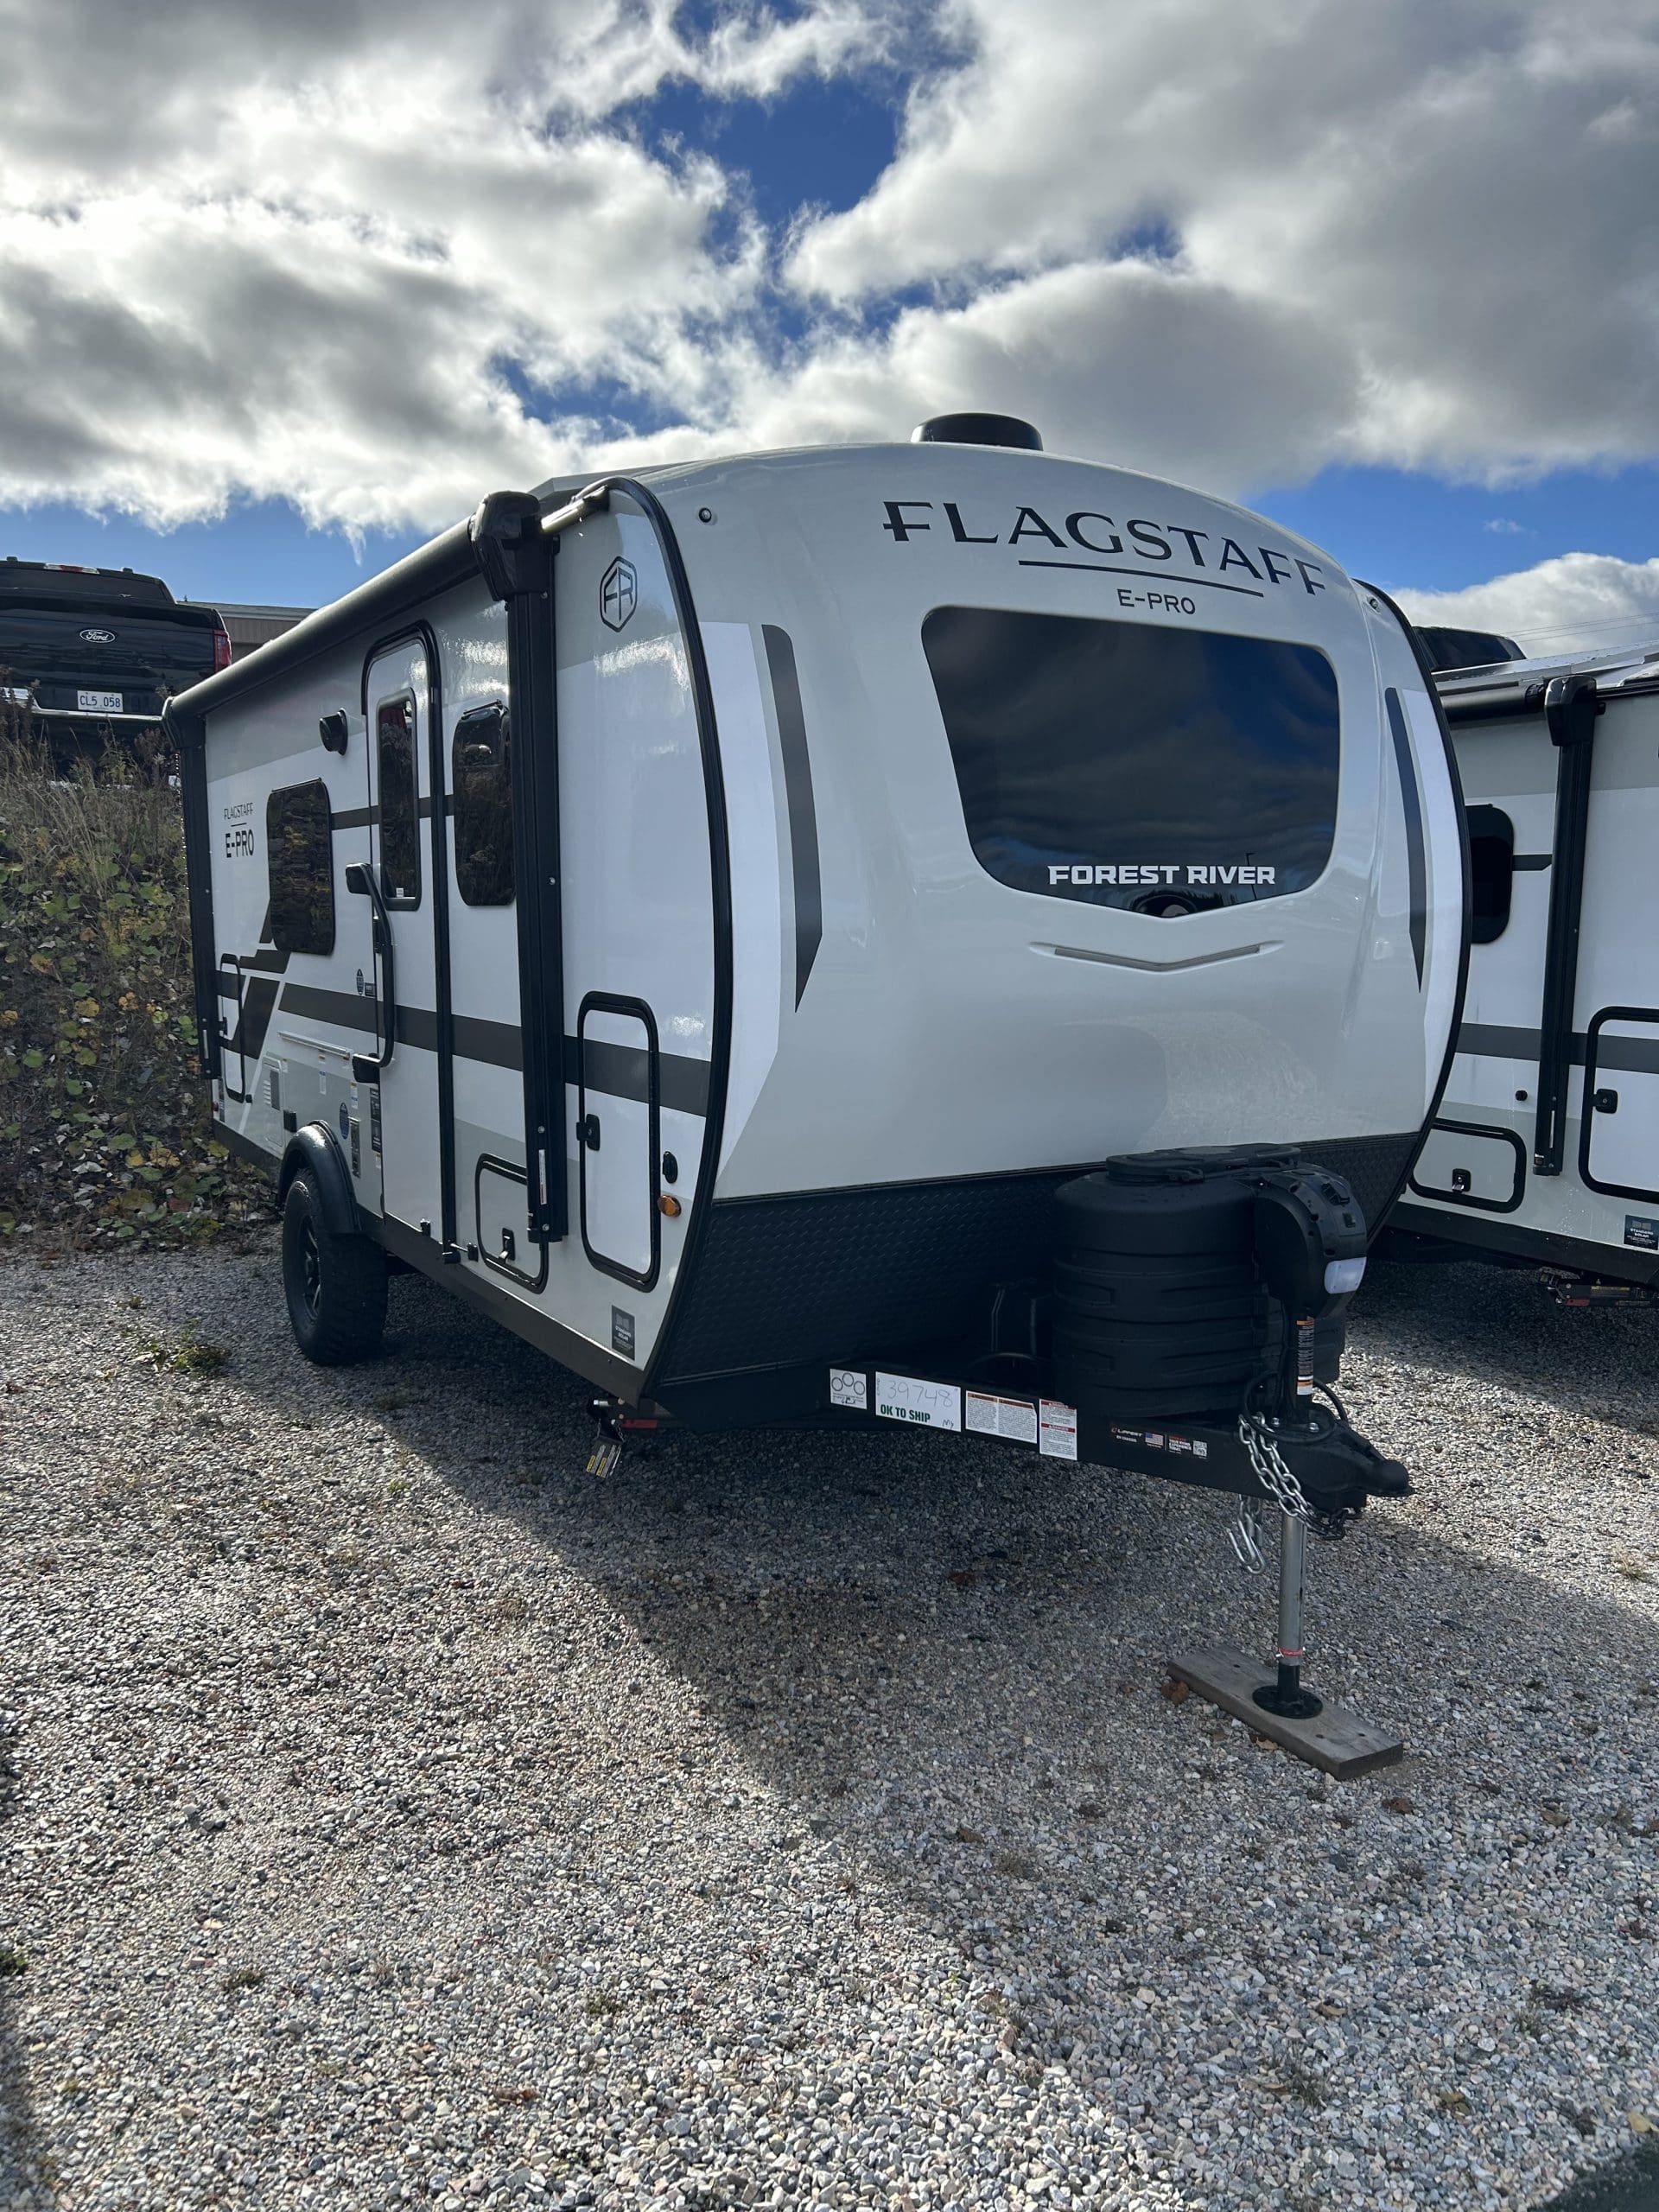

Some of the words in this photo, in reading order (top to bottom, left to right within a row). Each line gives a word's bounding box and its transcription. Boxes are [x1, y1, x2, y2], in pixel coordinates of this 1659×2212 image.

[883, 501, 1326, 596] FLAGSTAFF
[1116, 588, 1196, 615] E-PRO
[79, 695, 98, 707] CL5
[103, 696, 121, 708] 058
[224, 802, 254, 821] FLAGSTAFF
[225, 829, 255, 858] E-PRO
[1047, 865, 1179, 885] FOREST
[1186, 866, 1275, 885] RIVER
[880, 1404, 893, 1416] OK
[895, 1407, 906, 1419] TO
[908, 1409, 931, 1423] SHIP
